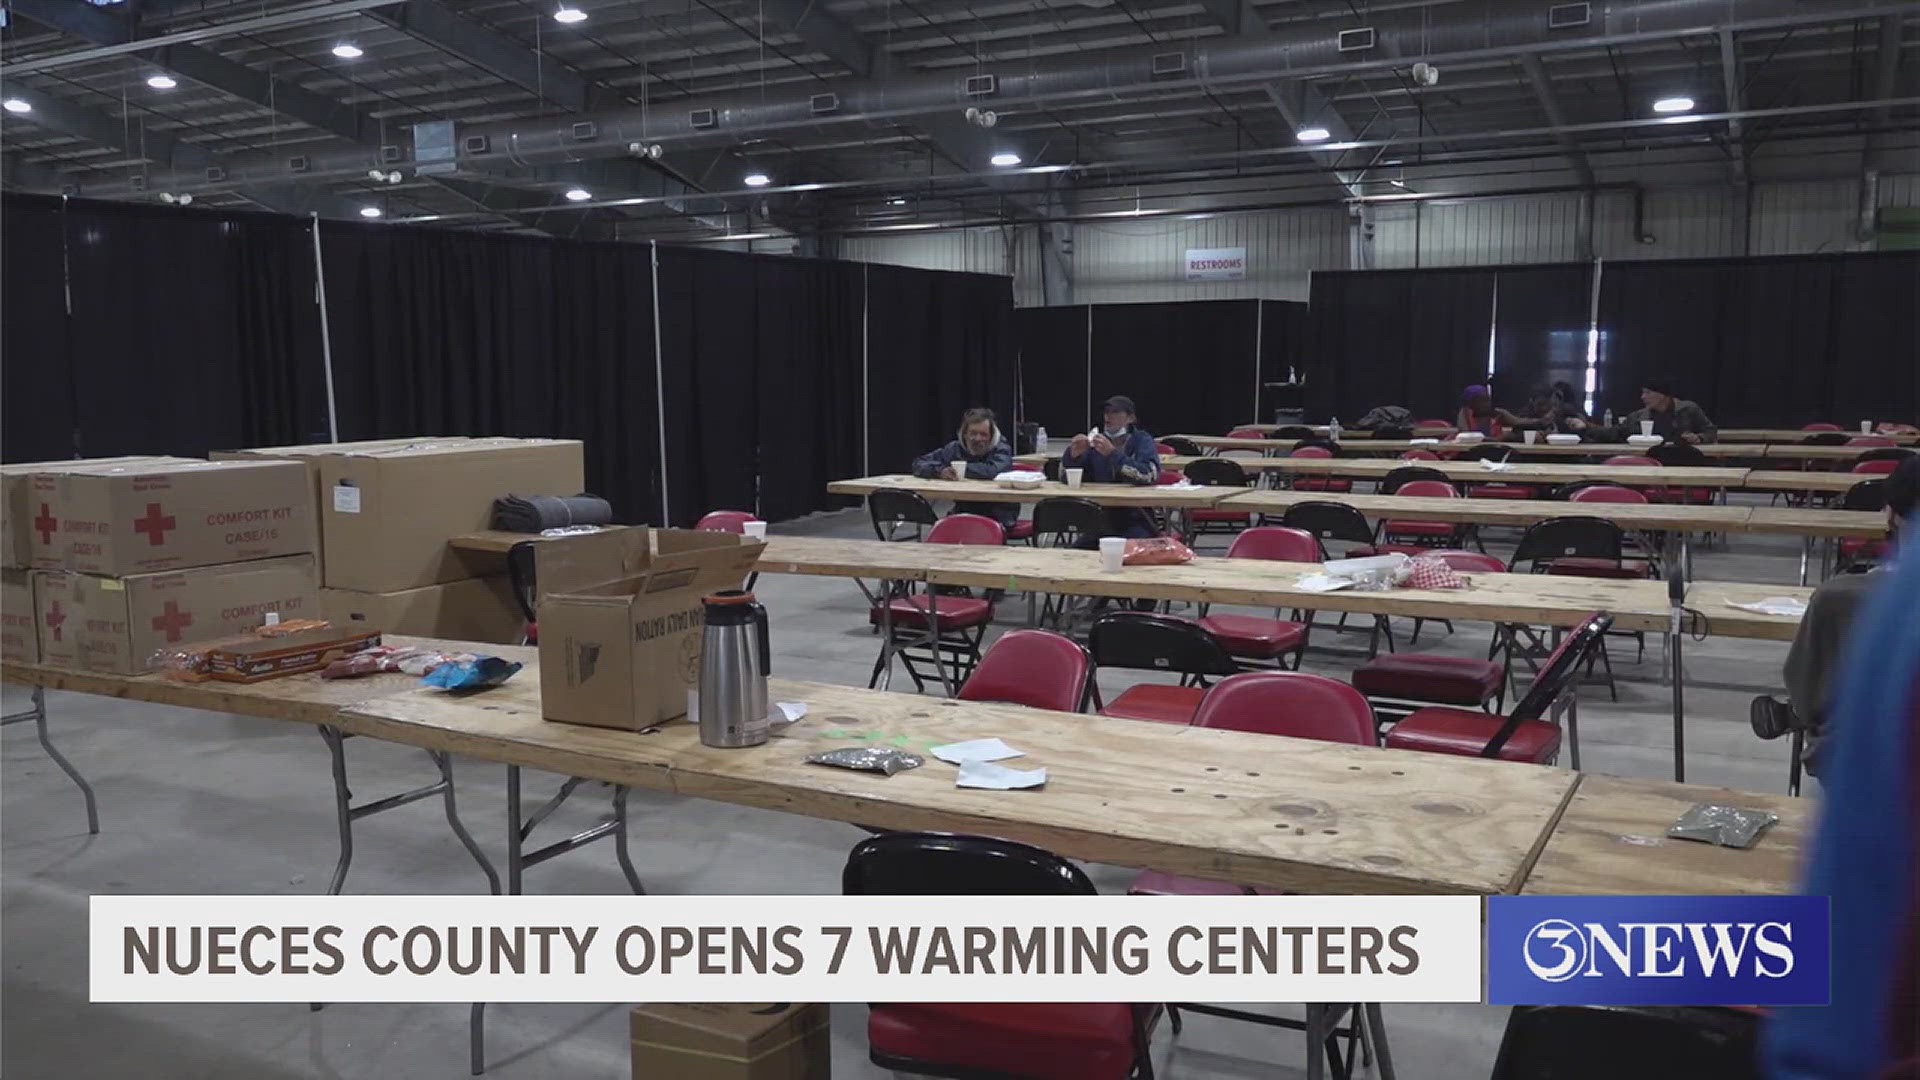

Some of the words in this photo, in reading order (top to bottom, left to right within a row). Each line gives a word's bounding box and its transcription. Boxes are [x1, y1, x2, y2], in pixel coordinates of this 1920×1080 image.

[1190, 258, 1242, 270] RESTROOMS
[207, 509, 270, 526] COMFORT
[272, 507, 291, 520] KIT
[221, 601, 281, 620] COMFORT
[285, 597, 304, 611] KIT
[635, 616, 665, 642] RATION
